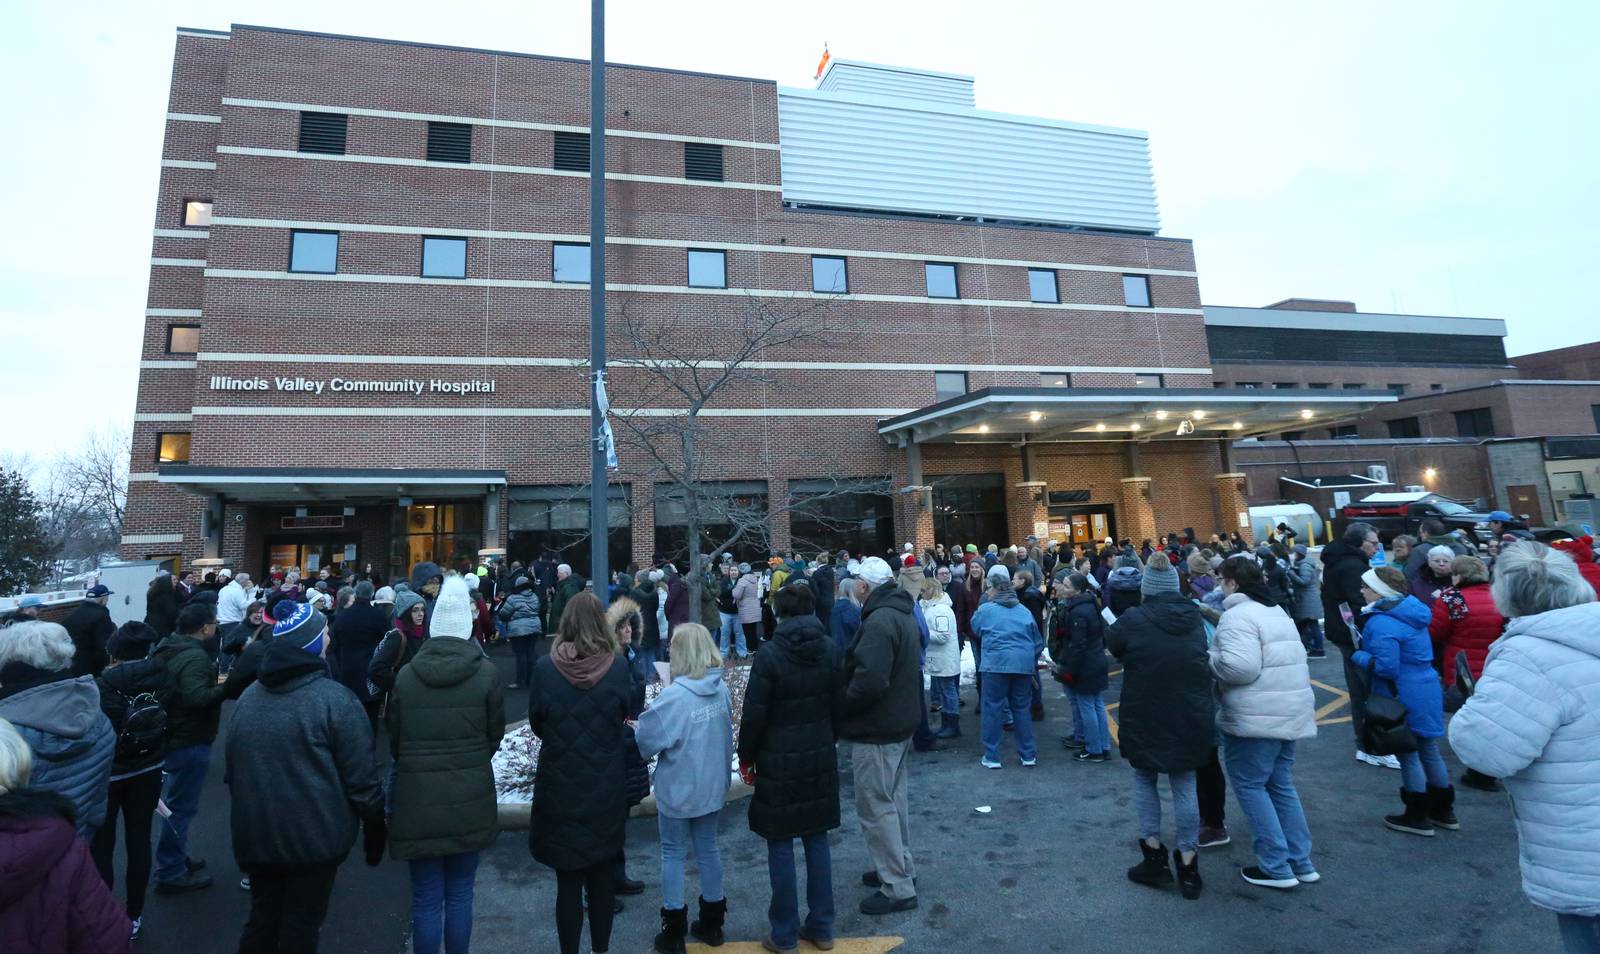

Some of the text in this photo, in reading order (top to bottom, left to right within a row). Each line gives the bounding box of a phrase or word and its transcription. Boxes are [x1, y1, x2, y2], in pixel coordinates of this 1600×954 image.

[210, 376, 495, 395] Illinois Valley Community Hospital
